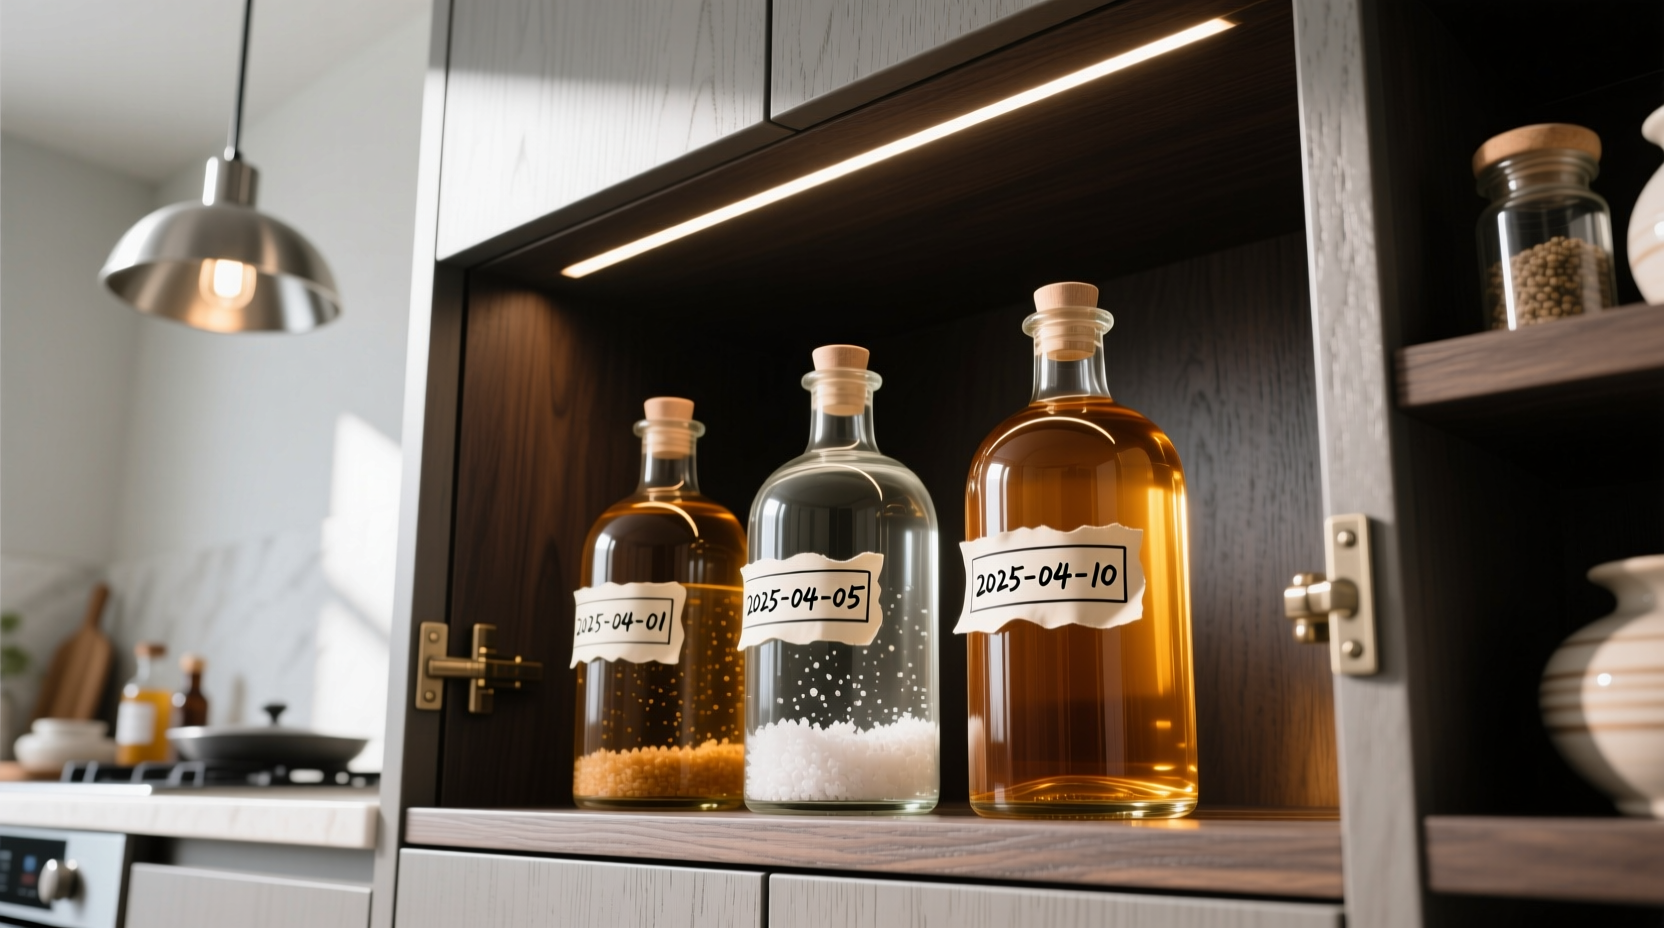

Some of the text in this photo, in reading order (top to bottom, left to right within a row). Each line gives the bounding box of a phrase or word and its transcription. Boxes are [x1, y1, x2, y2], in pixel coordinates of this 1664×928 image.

[976, 562, 1117, 598] 2025-04-10
[747, 585, 866, 616] 2025-04-05
[576, 611, 666, 636] 2025-04-01
